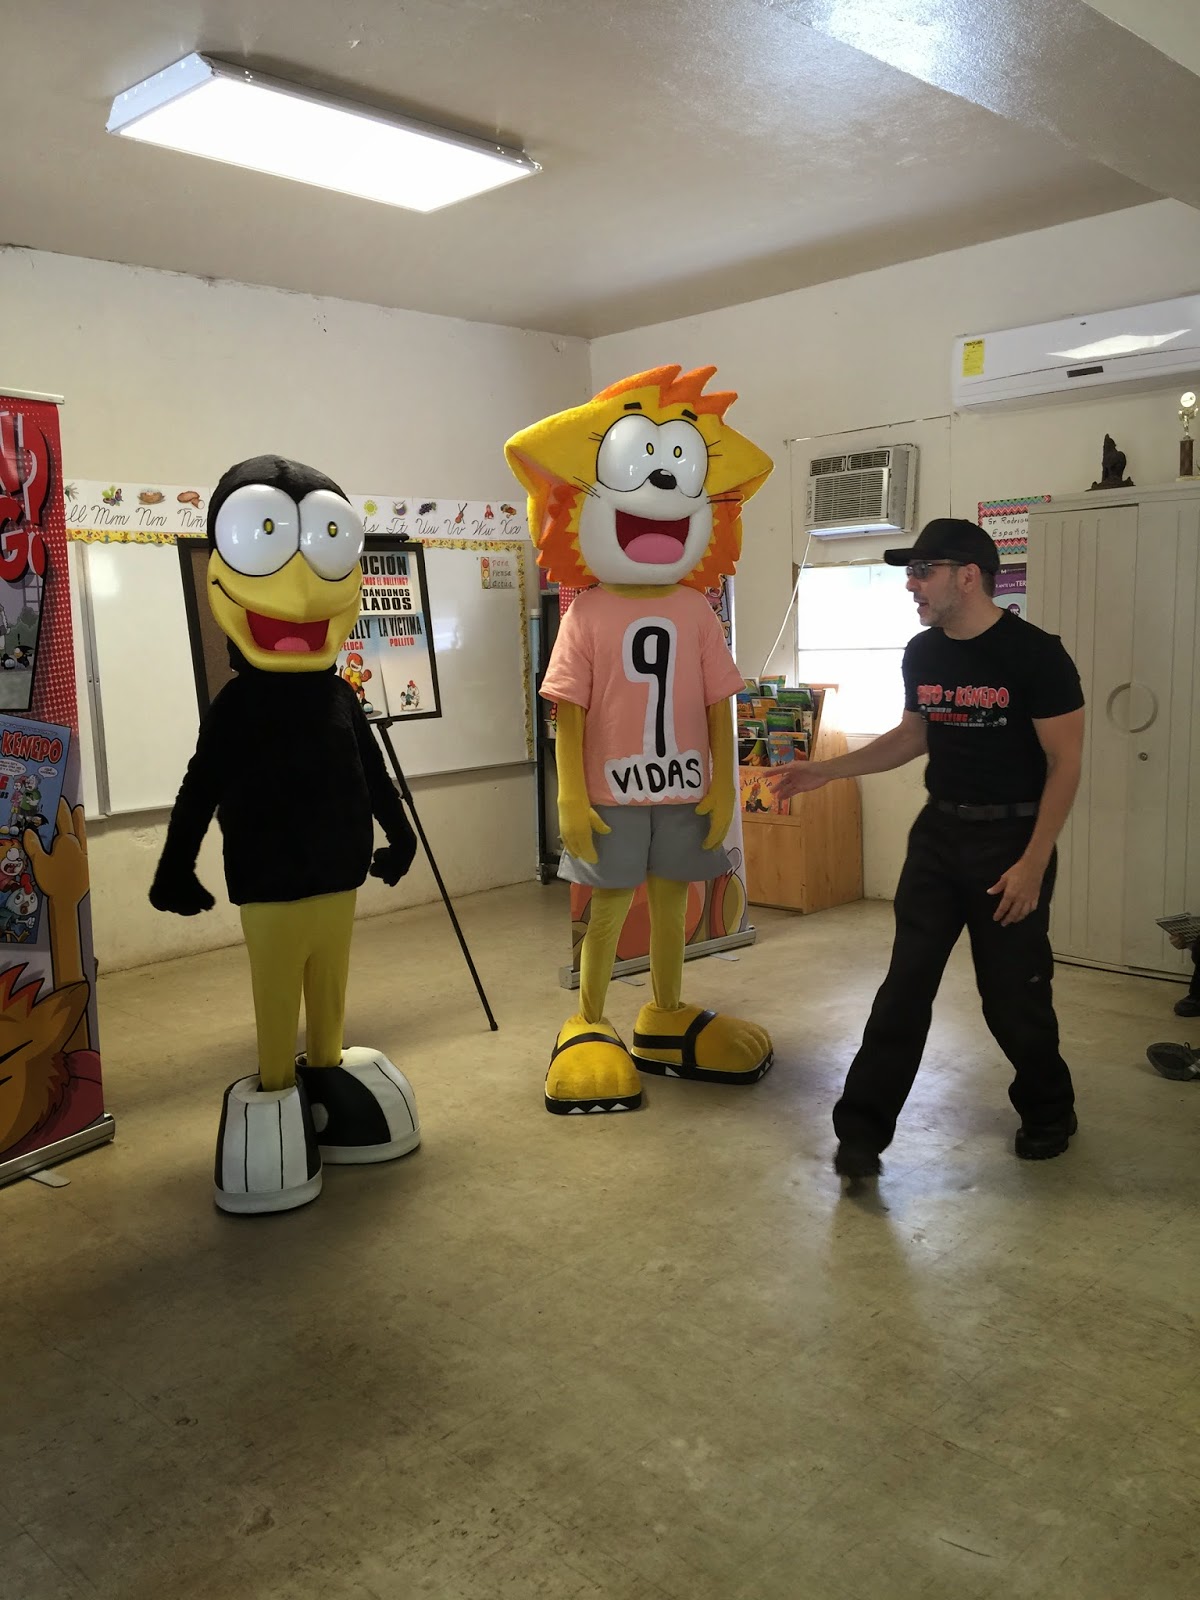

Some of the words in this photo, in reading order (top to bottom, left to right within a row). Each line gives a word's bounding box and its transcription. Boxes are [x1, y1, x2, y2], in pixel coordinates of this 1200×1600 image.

[360, 597, 412, 611] LADOS
[378, 617, 389, 637] LA
[389, 615, 423, 636] VÍCTIMA
[389, 637, 415, 647] POLLITO
[632, 626, 671, 758] 9
[955, 685, 1010, 709] KENEPO
[2, 730, 63, 764] KENEPO
[612, 758, 702, 794] VIDAS
